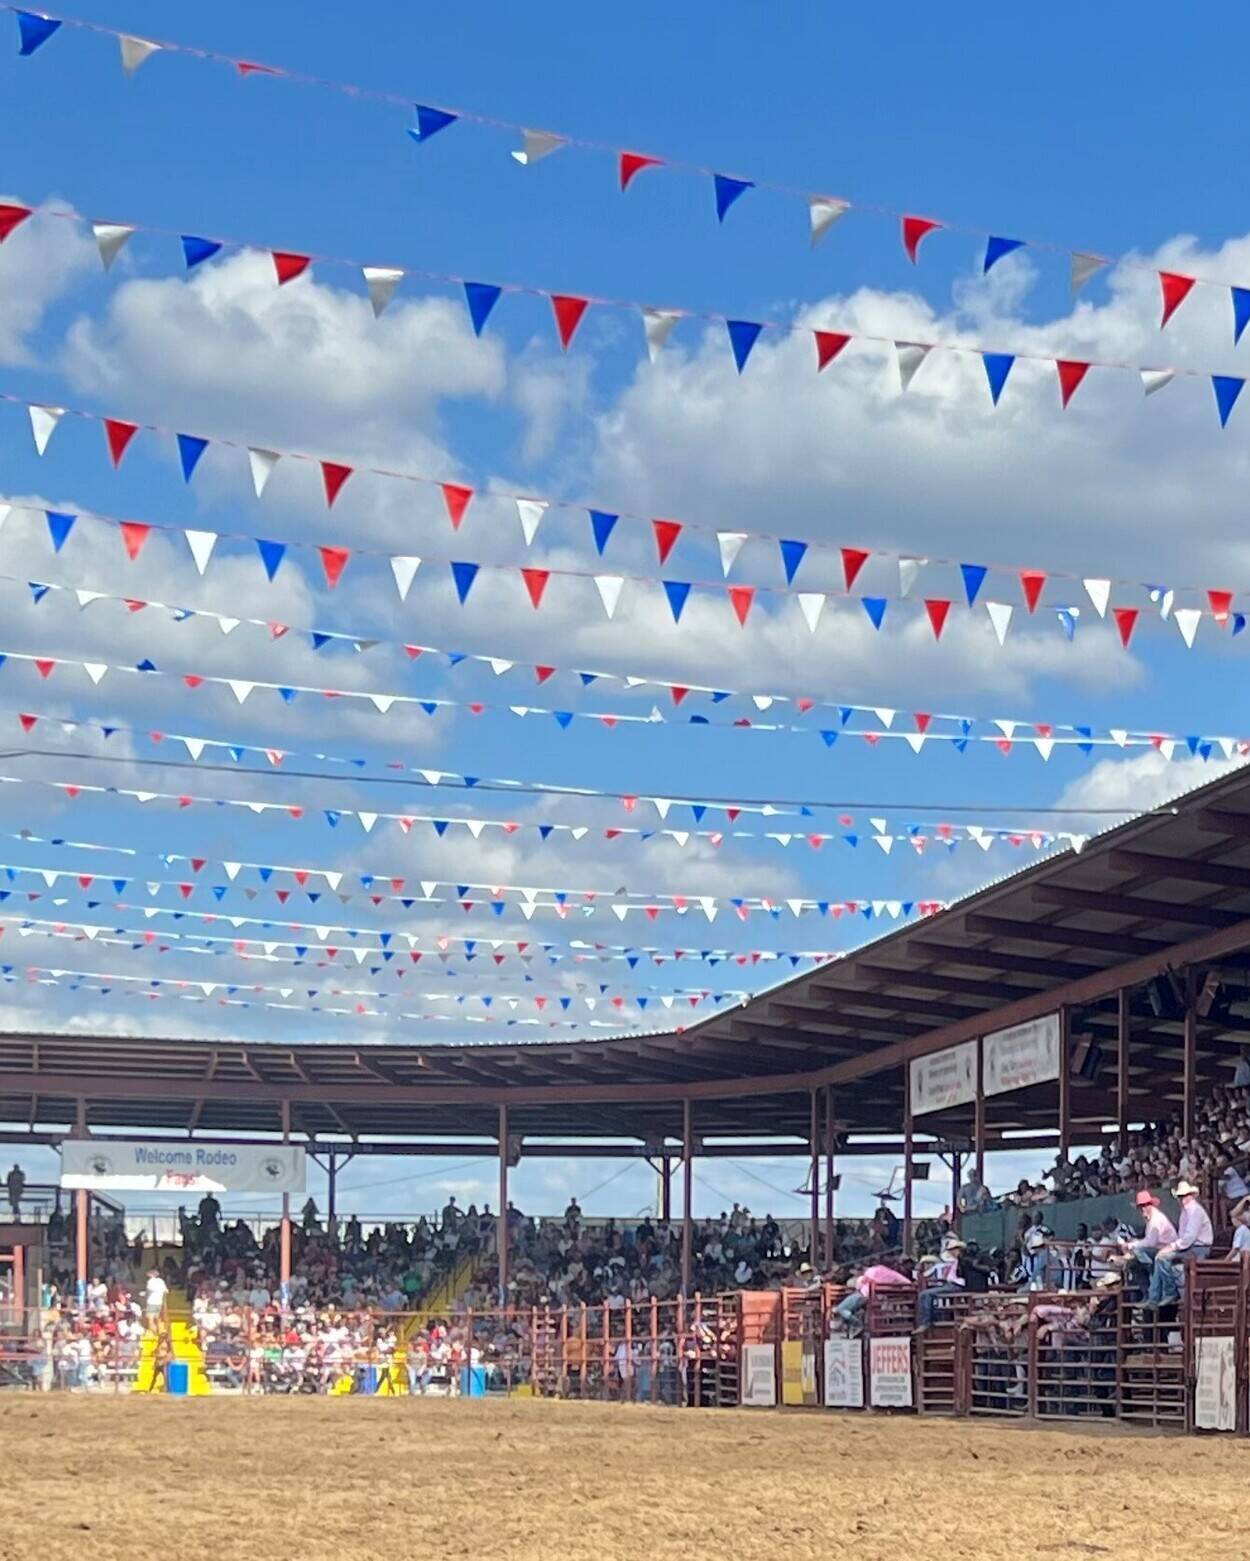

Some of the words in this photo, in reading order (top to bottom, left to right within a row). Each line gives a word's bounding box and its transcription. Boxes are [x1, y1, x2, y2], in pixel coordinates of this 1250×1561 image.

[135, 1147, 192, 1164] Welcome
[196, 1148, 237, 1165] Rodeo
[872, 1344, 908, 1374] JEFFERS
